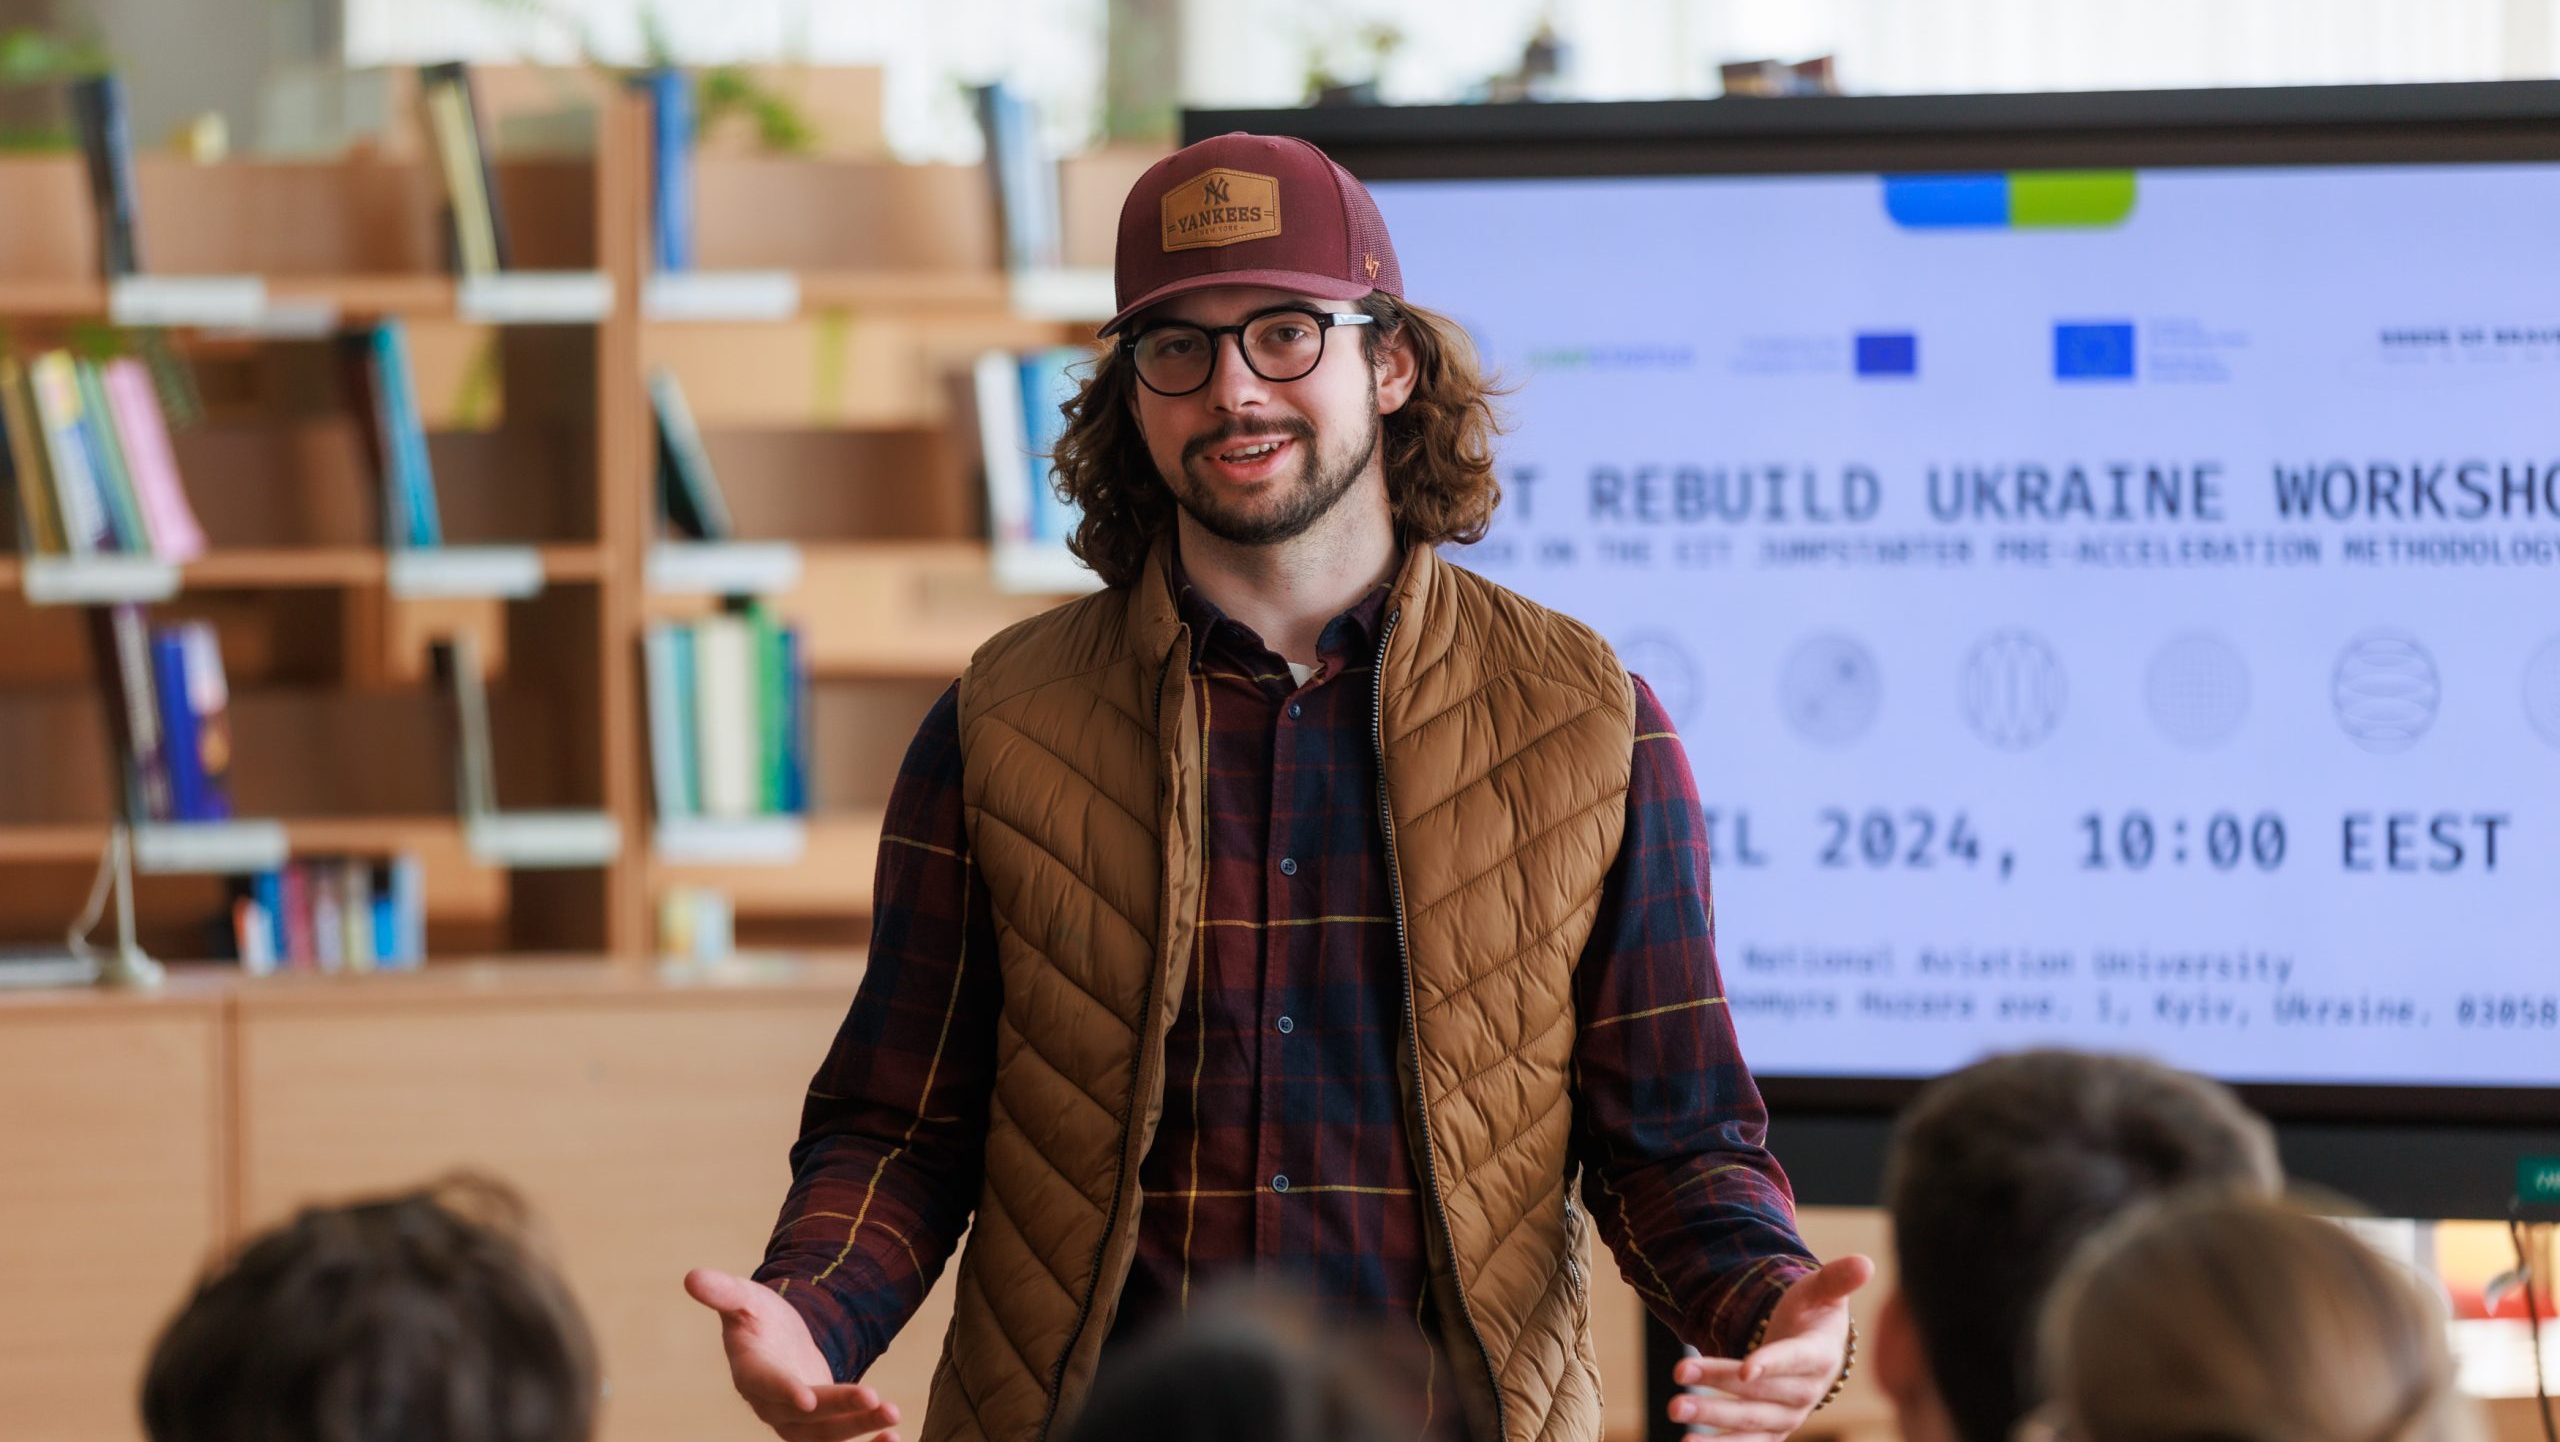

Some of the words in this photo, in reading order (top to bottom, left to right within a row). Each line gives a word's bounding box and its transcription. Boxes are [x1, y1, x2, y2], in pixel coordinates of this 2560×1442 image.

[1178, 206, 1262, 233] YANKEES
[1588, 464, 1882, 523] REBUILD
[1927, 463, 2222, 521] UKRAINE
[1818, 808, 2015, 880] 2024,
[2081, 811, 2287, 871] 10:00
[2342, 813, 2510, 872] EEST
